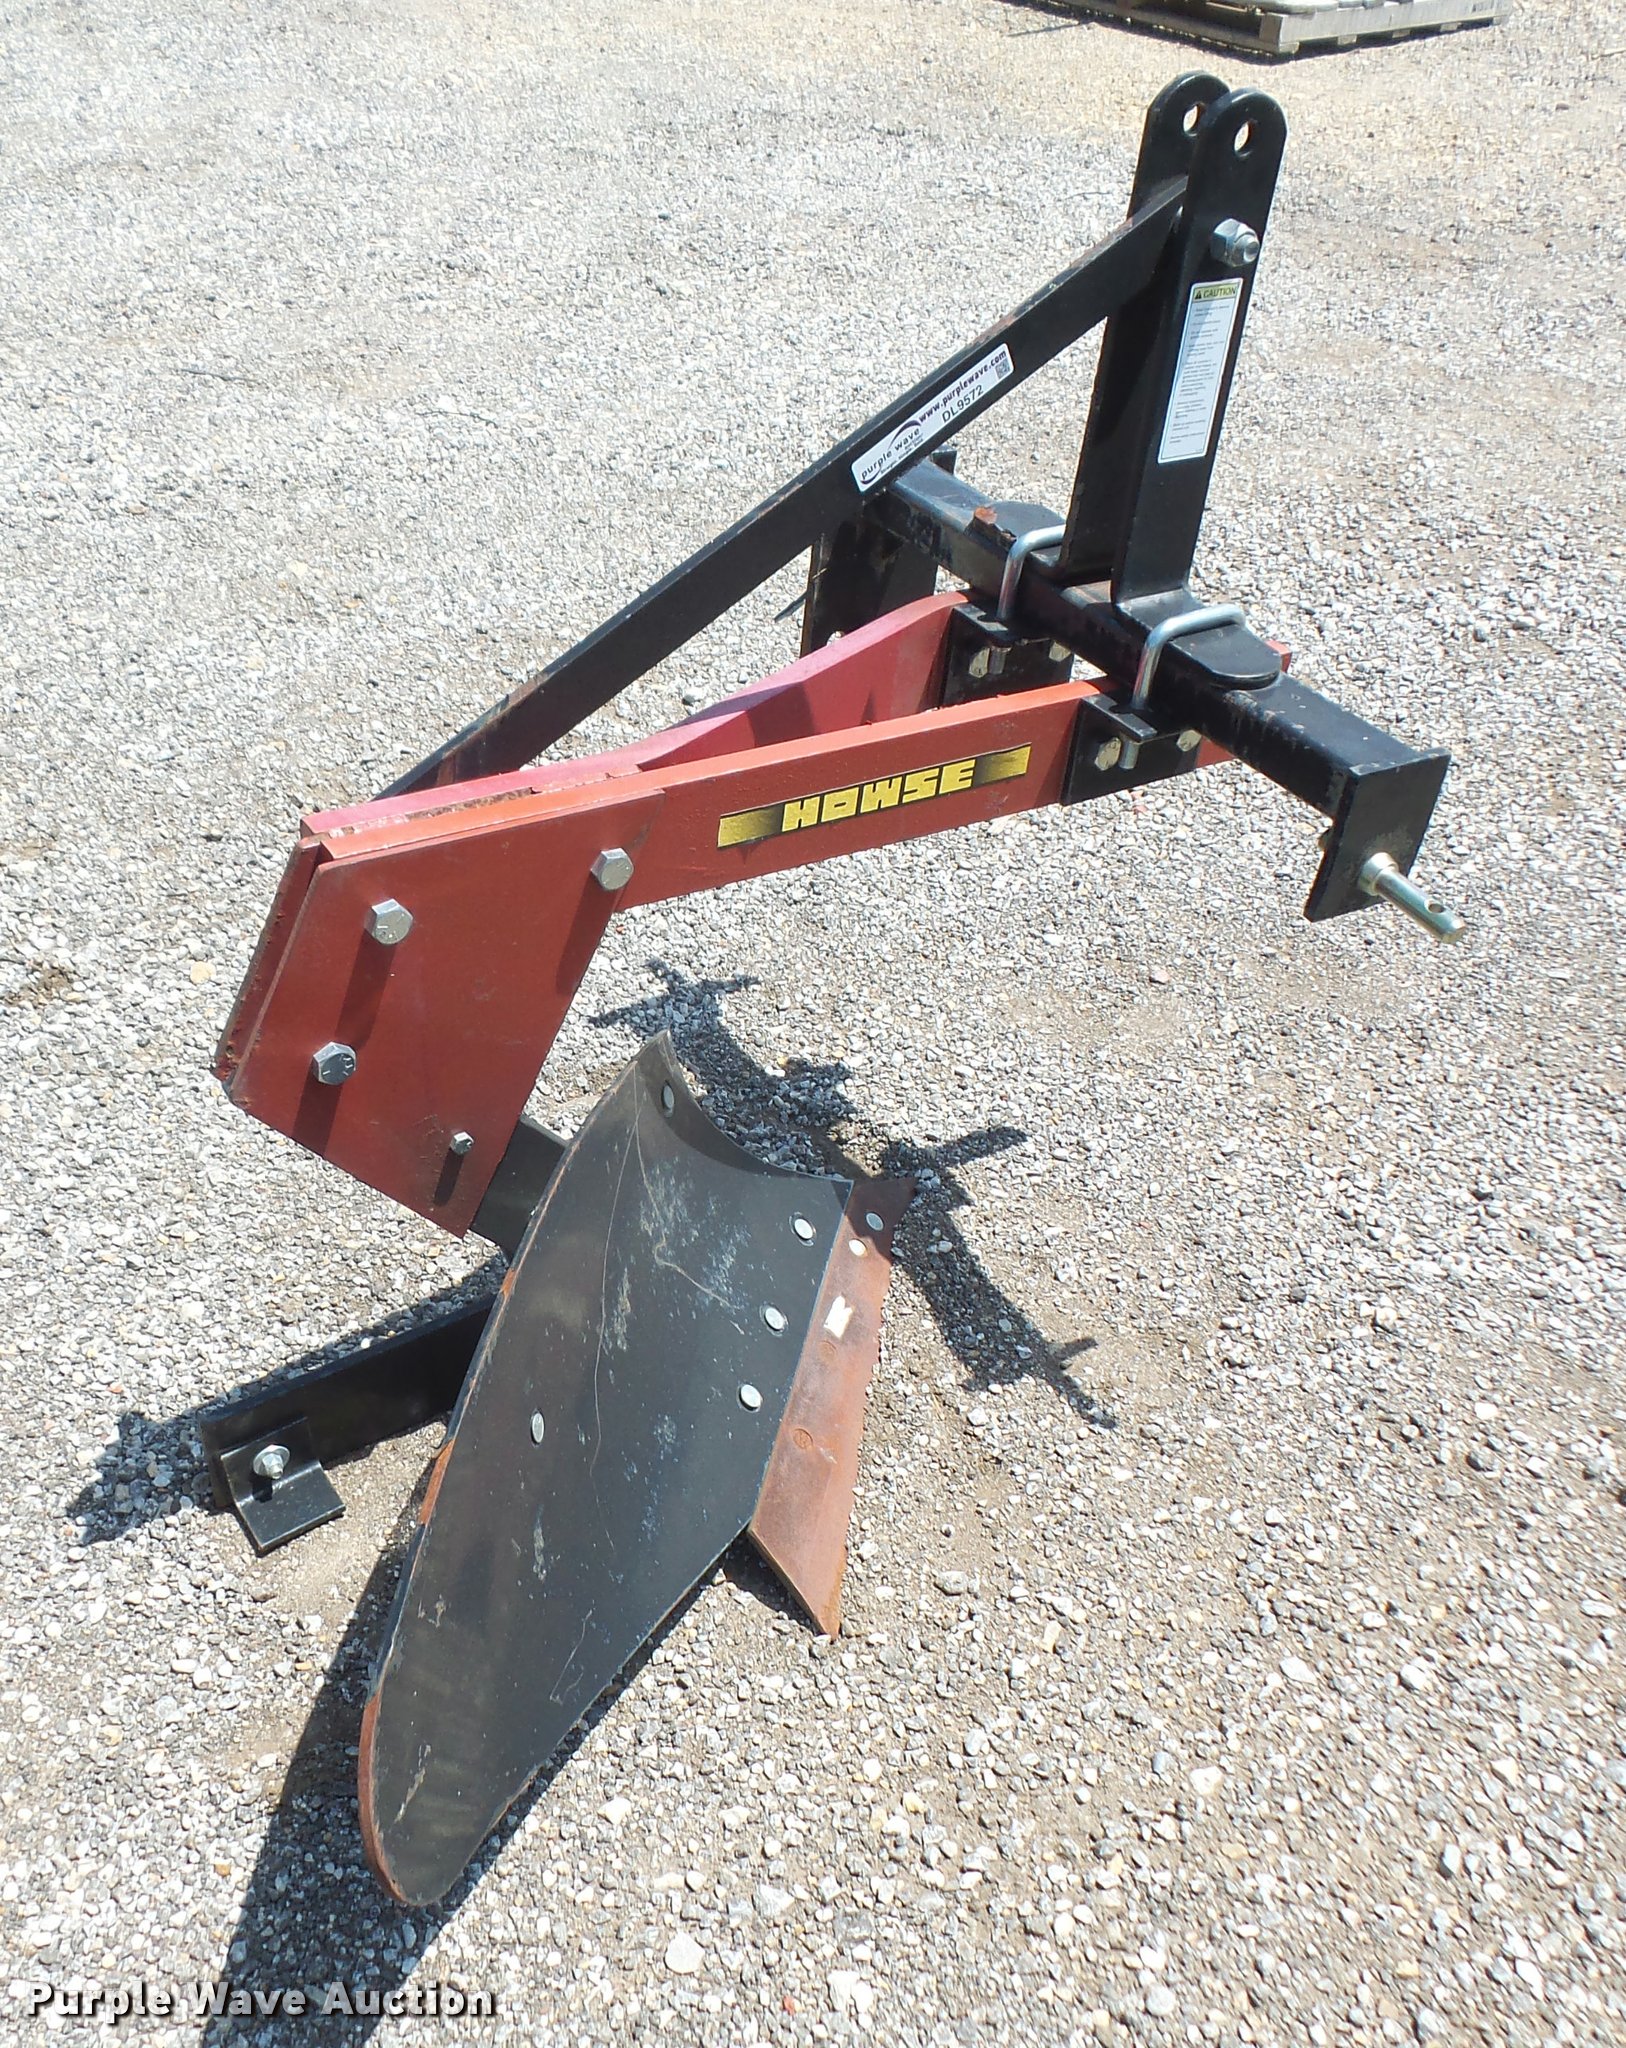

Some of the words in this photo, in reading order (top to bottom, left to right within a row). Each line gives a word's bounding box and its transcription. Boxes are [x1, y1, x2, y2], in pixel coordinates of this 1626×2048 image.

[1203, 285, 1237, 299] CAUTION
[919, 350, 1007, 423] www.purplewave.com
[942, 384, 985, 423] DL9572
[861, 450, 893, 481] purple
[894, 427, 921, 452] wave
[782, 758, 977, 833] HOWSE
